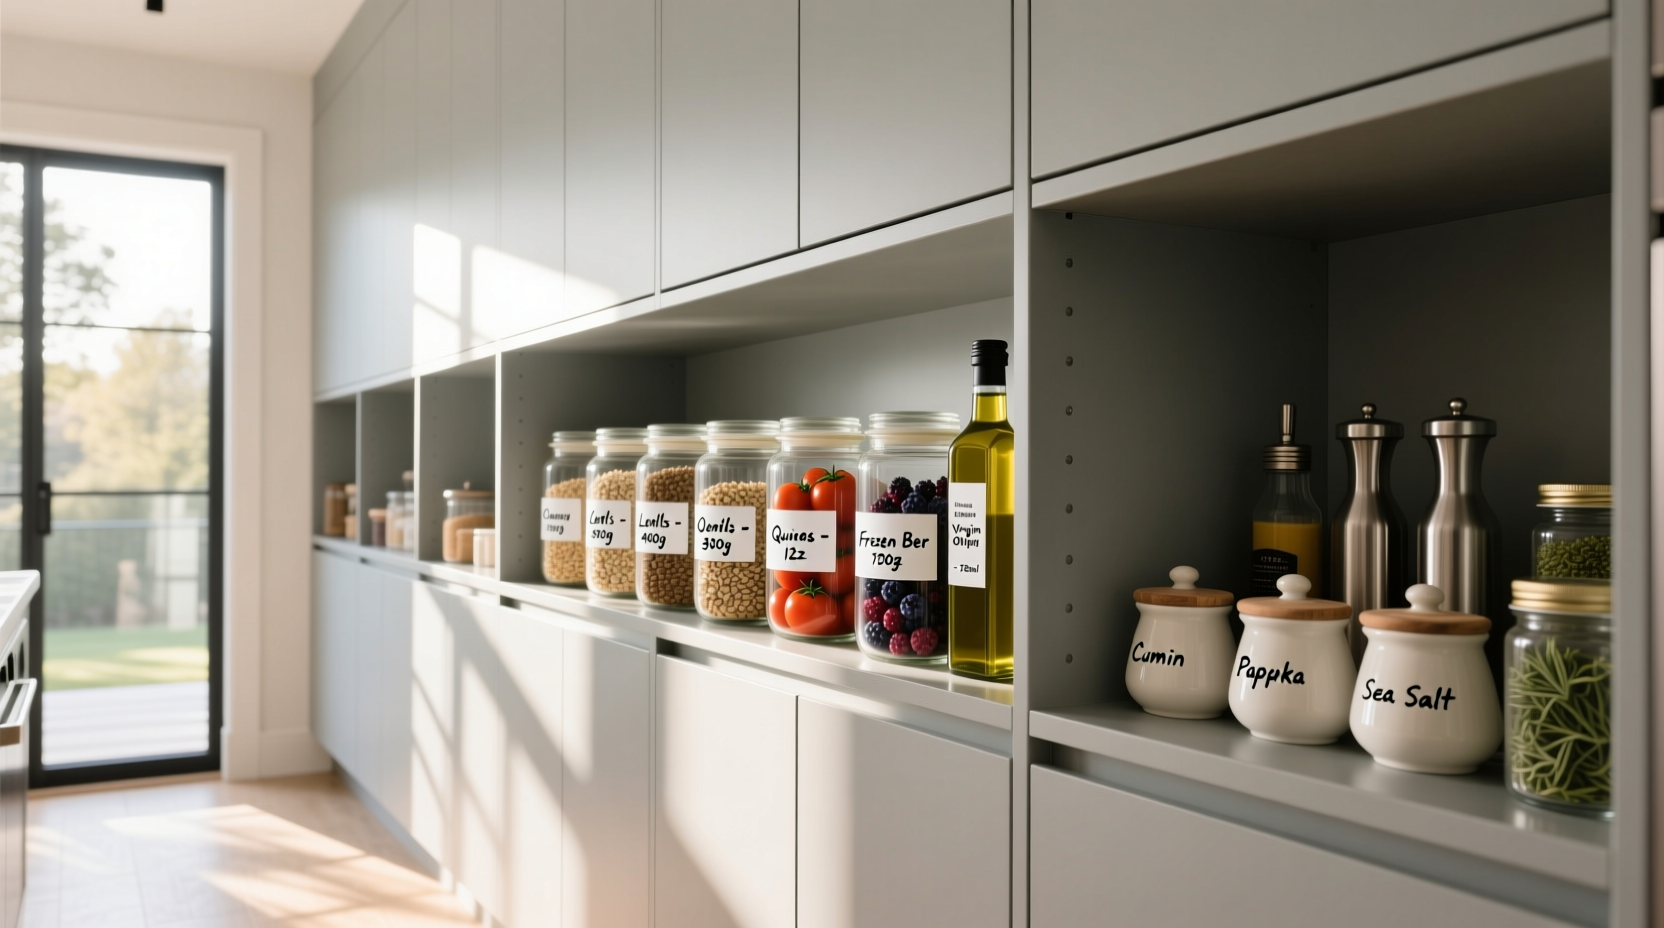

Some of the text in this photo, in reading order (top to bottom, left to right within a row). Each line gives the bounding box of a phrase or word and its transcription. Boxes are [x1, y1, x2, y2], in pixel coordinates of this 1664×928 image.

[641, 532, 667, 550] 400g
[701, 537, 732, 557] 300g
[902, 531, 930, 549] Ber
[1131, 641, 1185, 668] Cumin
[1362, 678, 1457, 711] Sea Salt
